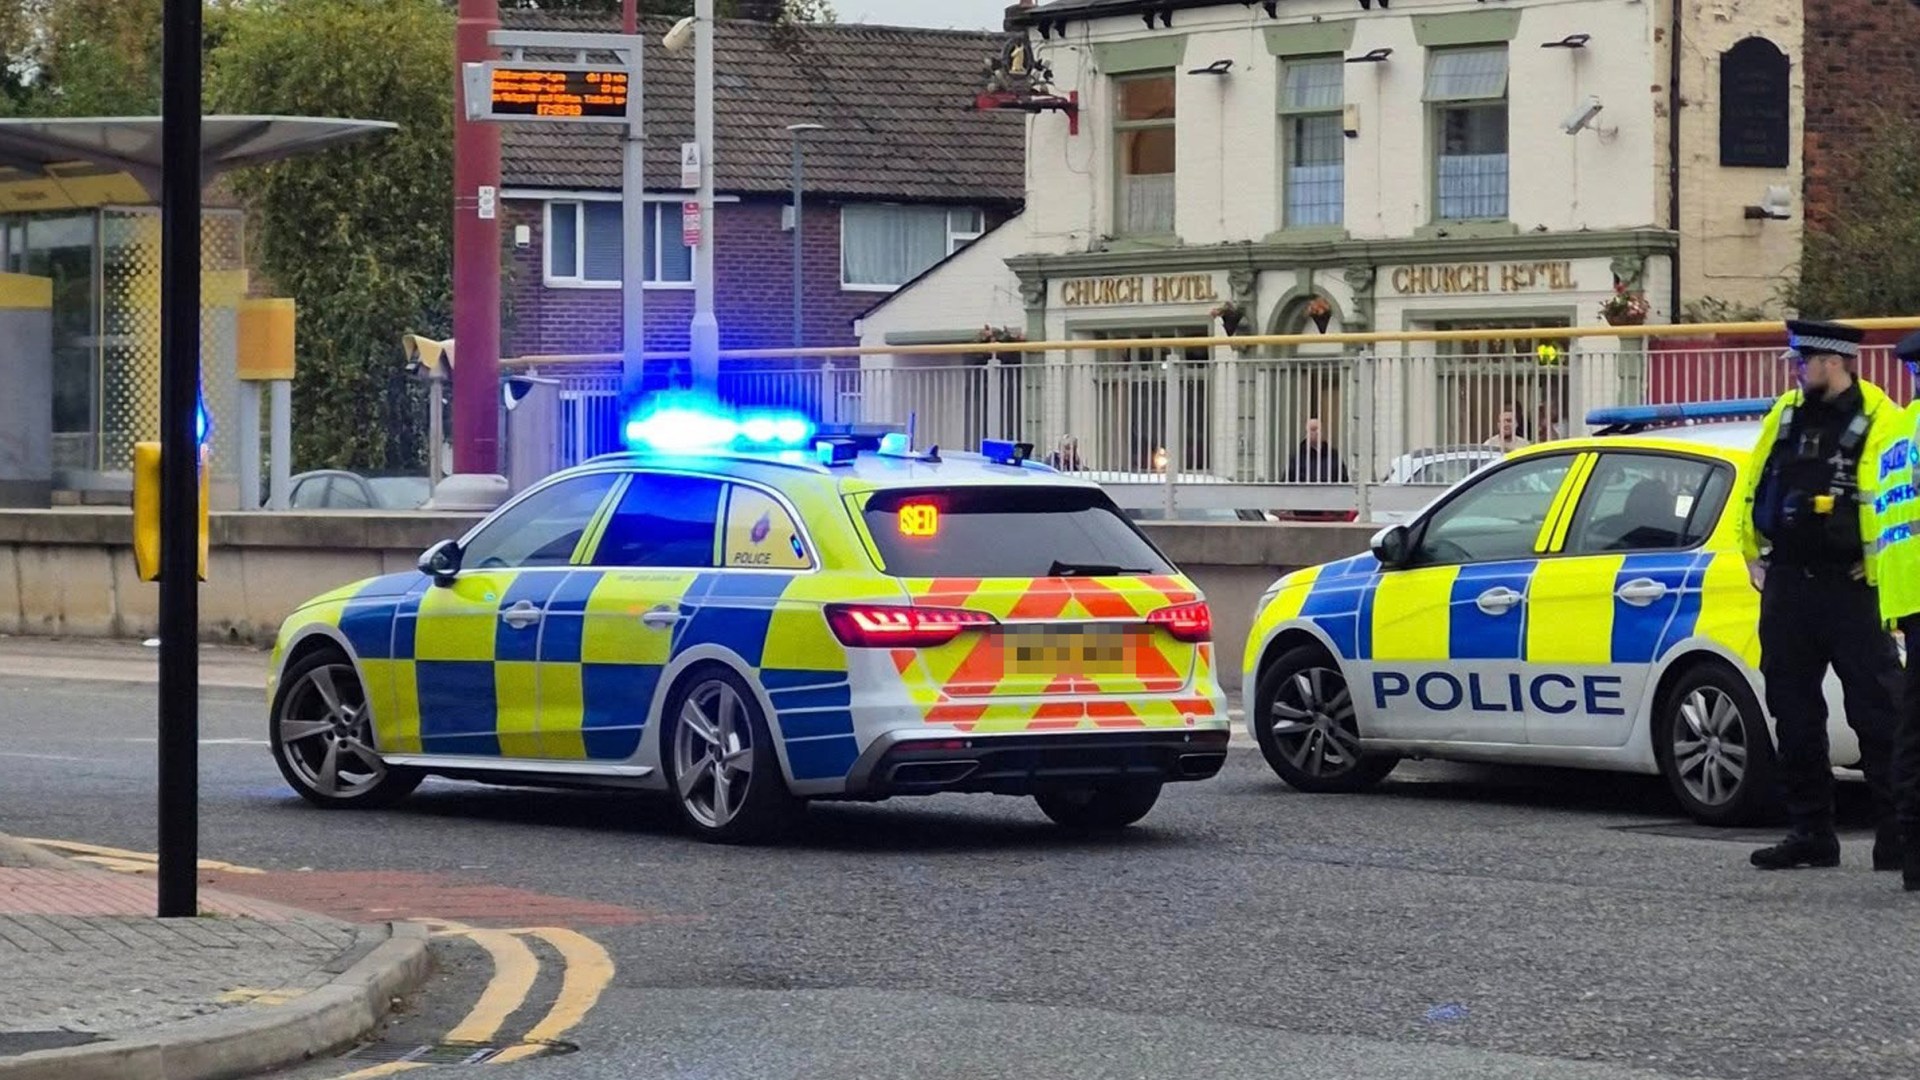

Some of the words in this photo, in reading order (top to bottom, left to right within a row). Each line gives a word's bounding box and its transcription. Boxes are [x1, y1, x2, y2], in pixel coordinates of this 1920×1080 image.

[1061, 276, 1144, 305] CHURCH
[1152, 273, 1218, 302] HOTEL
[1391, 263, 1489, 294] CHURCH
[733, 552, 772, 565] POLICE
[1371, 670, 1626, 716] POLICE
